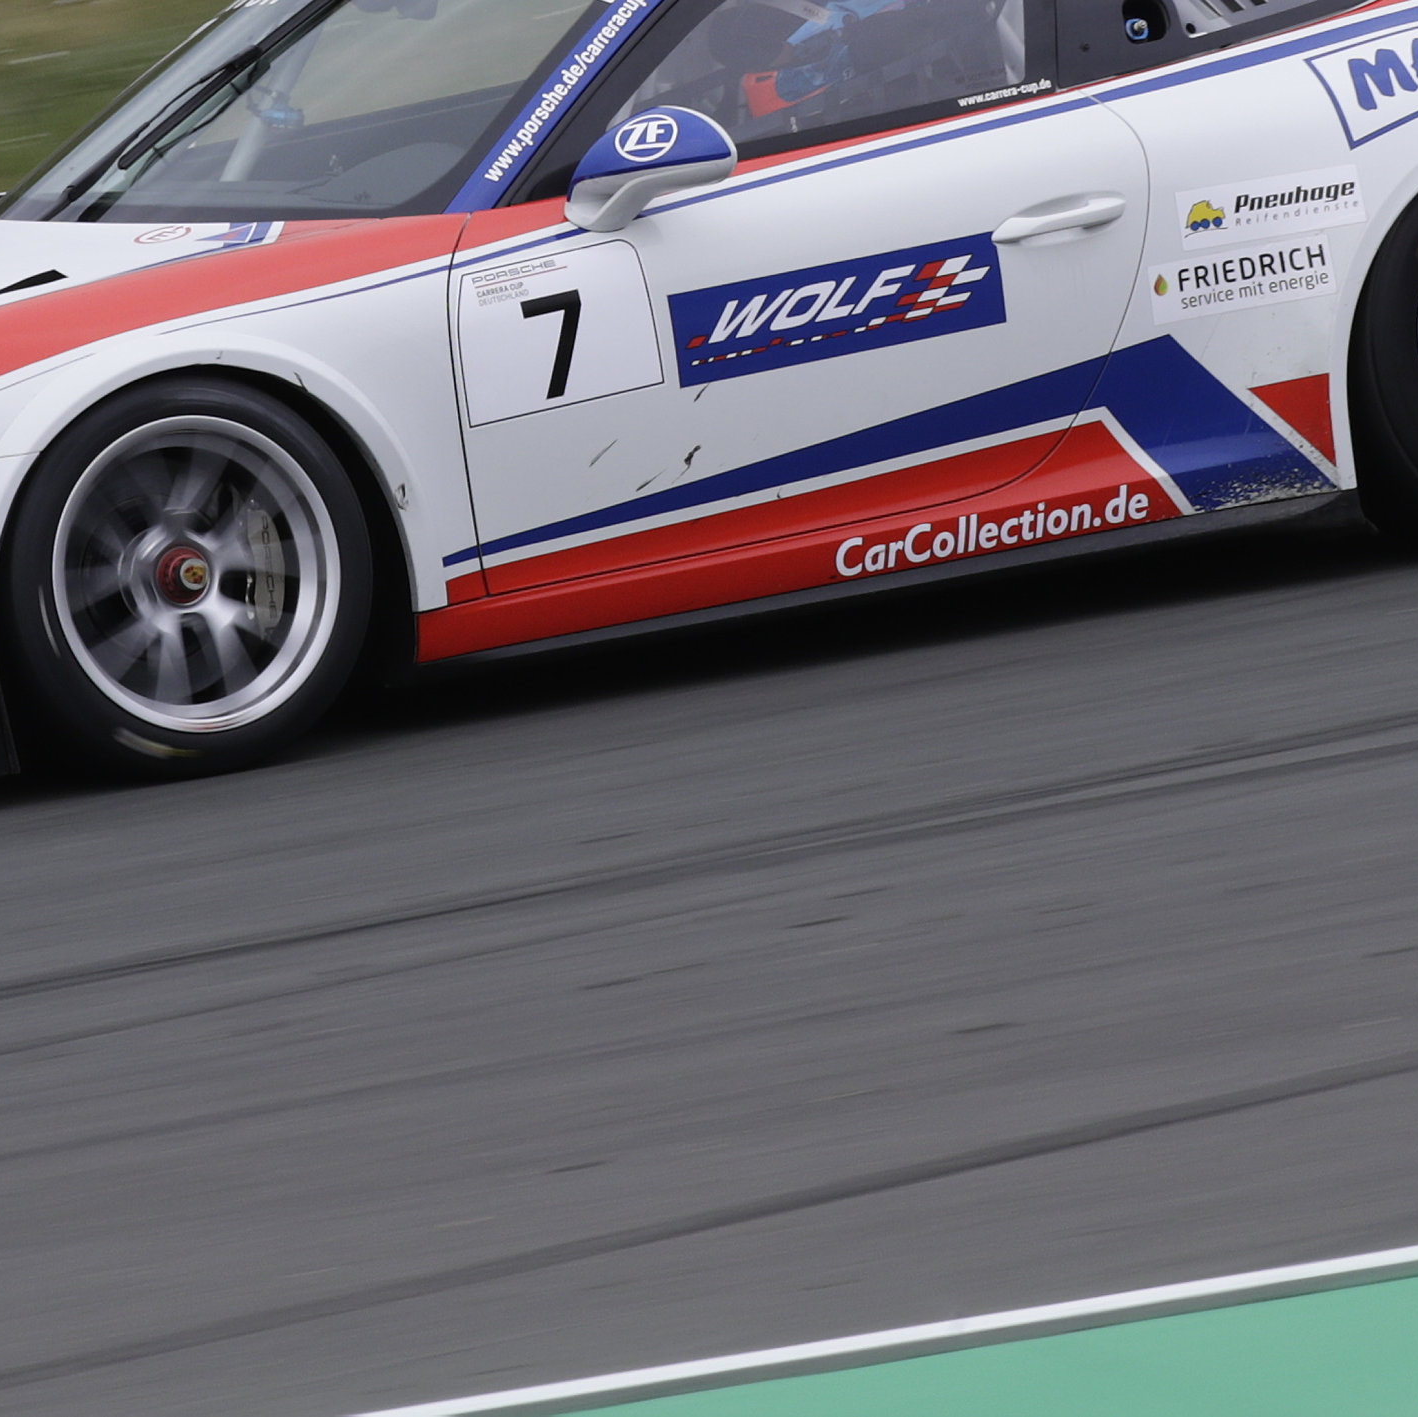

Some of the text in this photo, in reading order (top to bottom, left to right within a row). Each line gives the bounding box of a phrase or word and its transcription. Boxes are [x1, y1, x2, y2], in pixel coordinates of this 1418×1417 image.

[957, 78, 1052, 107] www.carrera-cup.de
[620, 119, 673, 153] ZF
[1235, 200, 1360, 227] Reifendienste
[471, 259, 557, 285] PORSCHE
[1177, 243, 1327, 292] FRIEDRICH
[476, 281, 525, 299] CARRERA CUP
[479, 288, 530, 307] DEUTSCHLAND
[707, 264, 917, 344] WOLF
[1181, 270, 1330, 309] service mit energie
[520, 289, 582, 400] 7
[835, 484, 1149, 578] CarCollection.de
[262, 515, 278, 620] PORCHE
